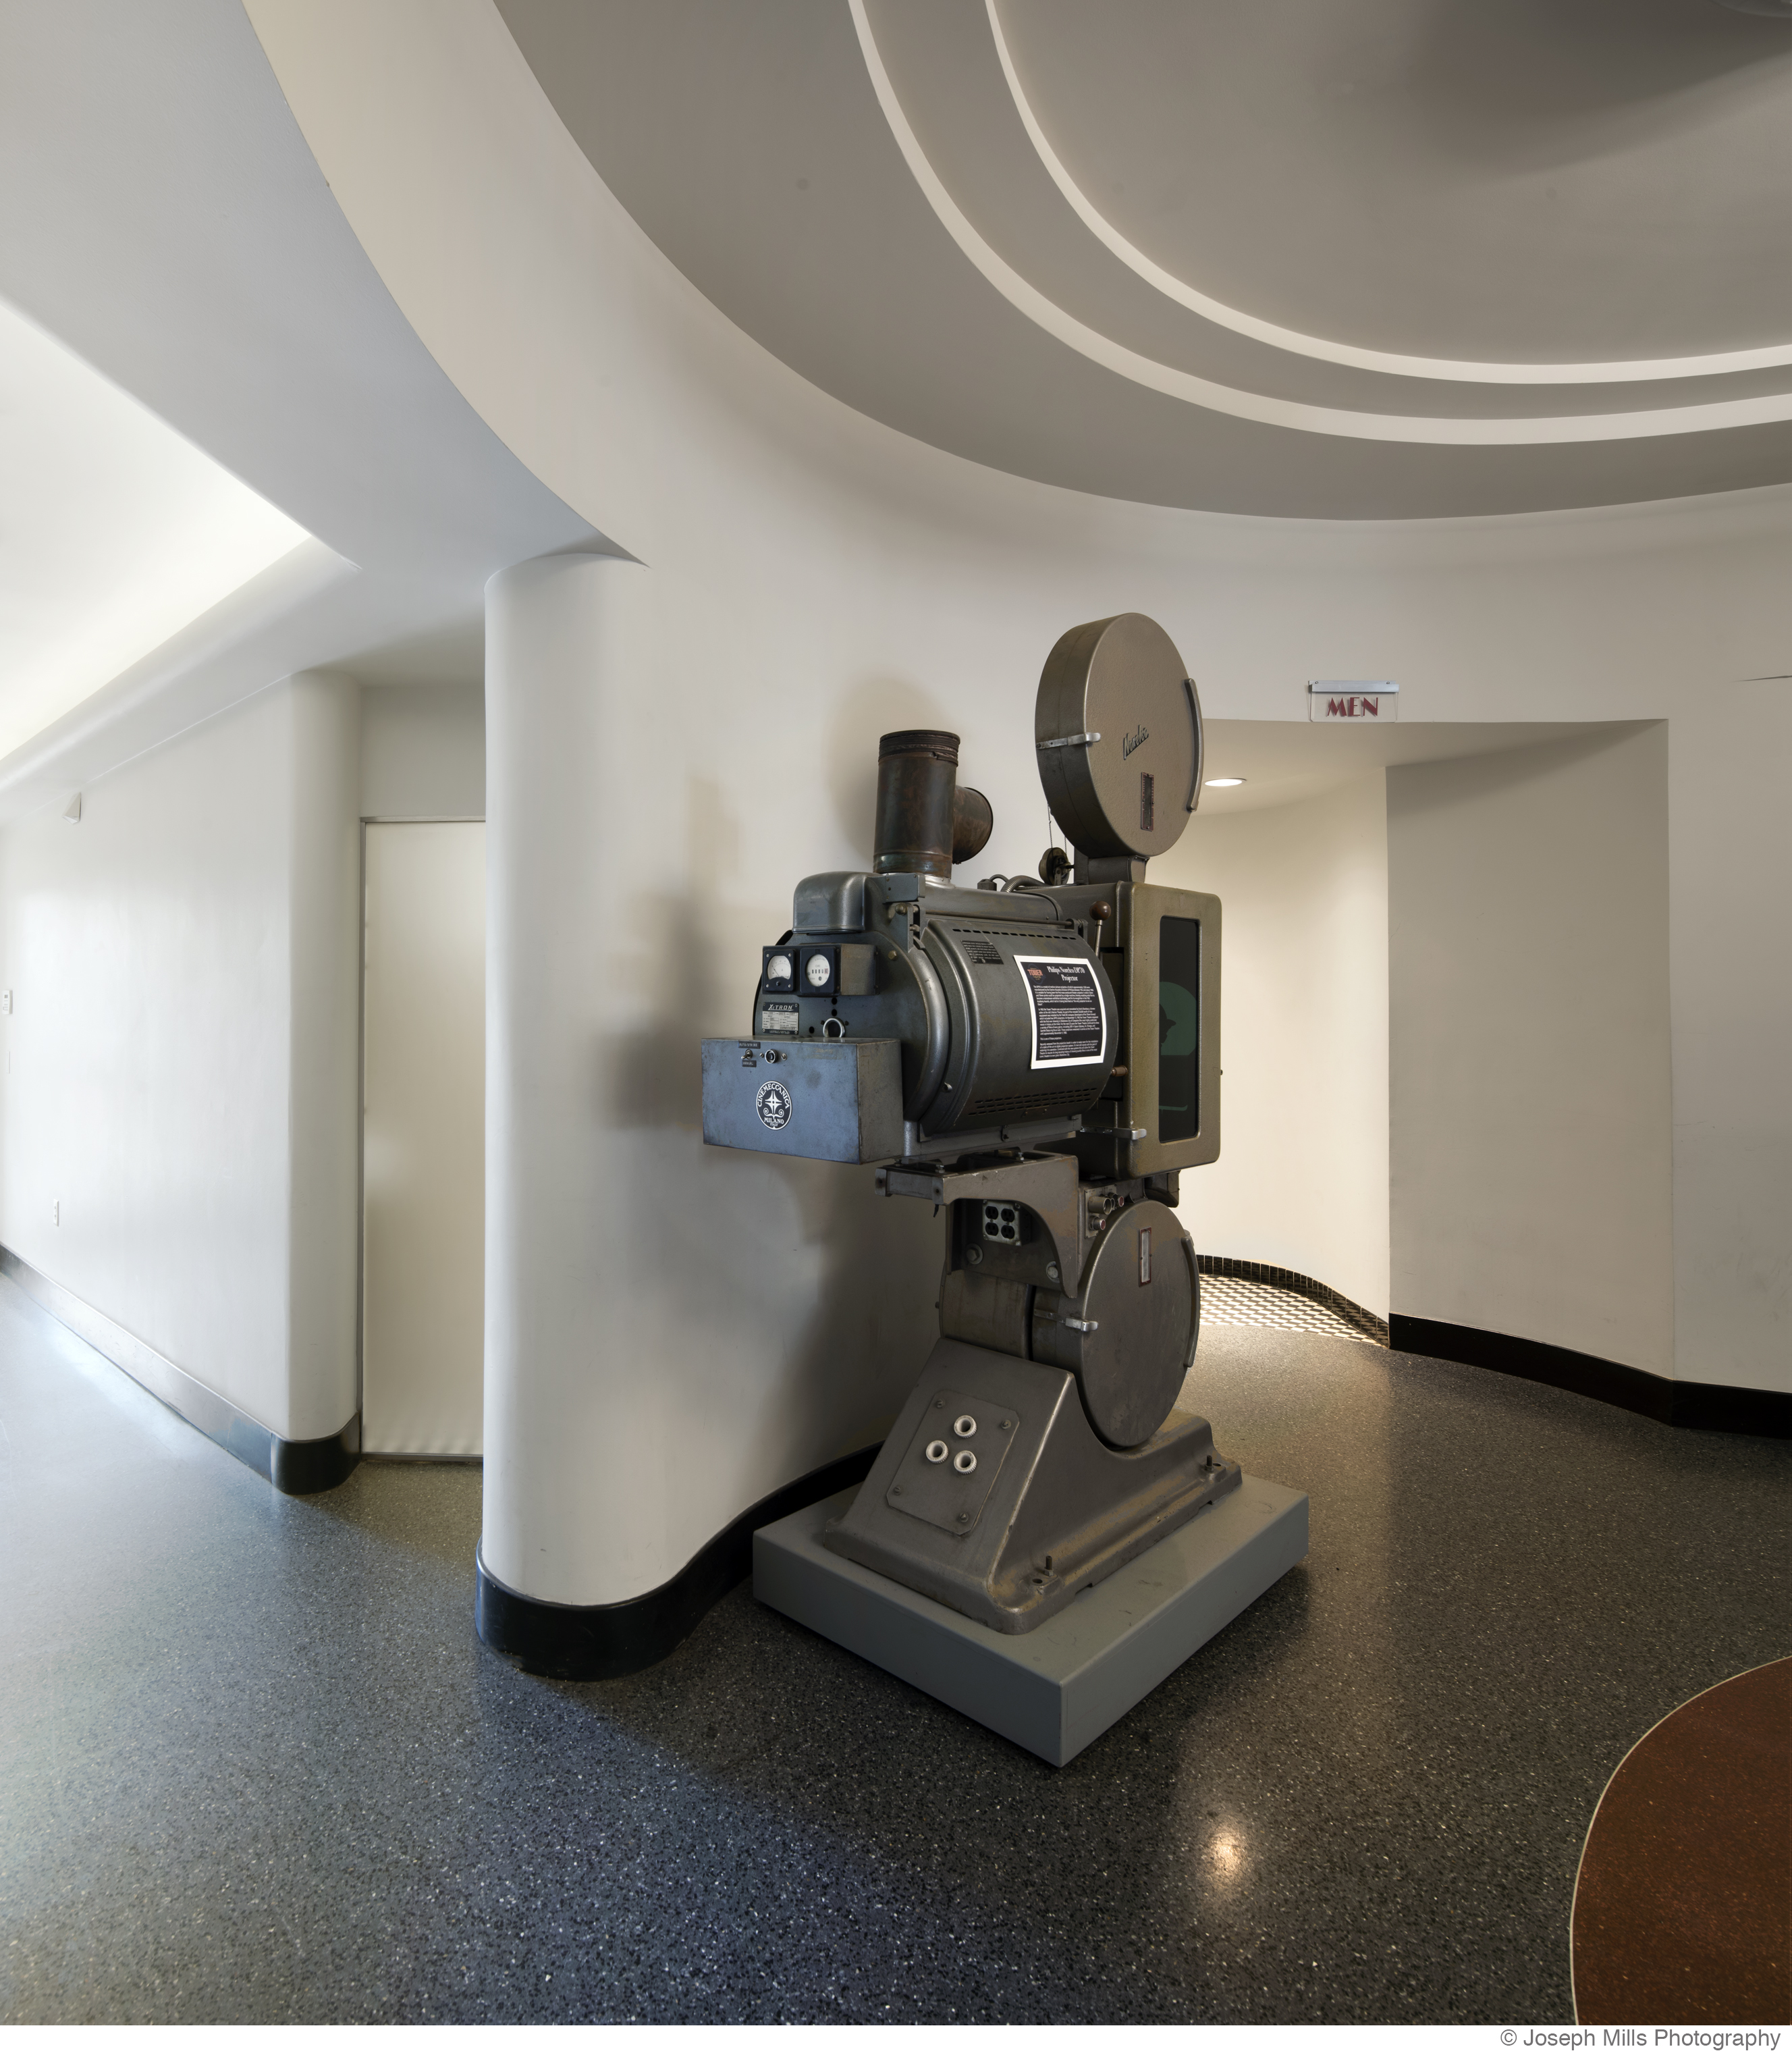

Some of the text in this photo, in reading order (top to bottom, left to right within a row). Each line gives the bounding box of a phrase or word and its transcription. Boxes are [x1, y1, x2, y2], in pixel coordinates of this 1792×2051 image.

[1327, 697, 1378, 716] MEN
[1047, 966, 1060, 975] Philips
[1061, 974, 1079, 983] Projector
[757, 1083, 790, 1109] CINEMECCANICA
